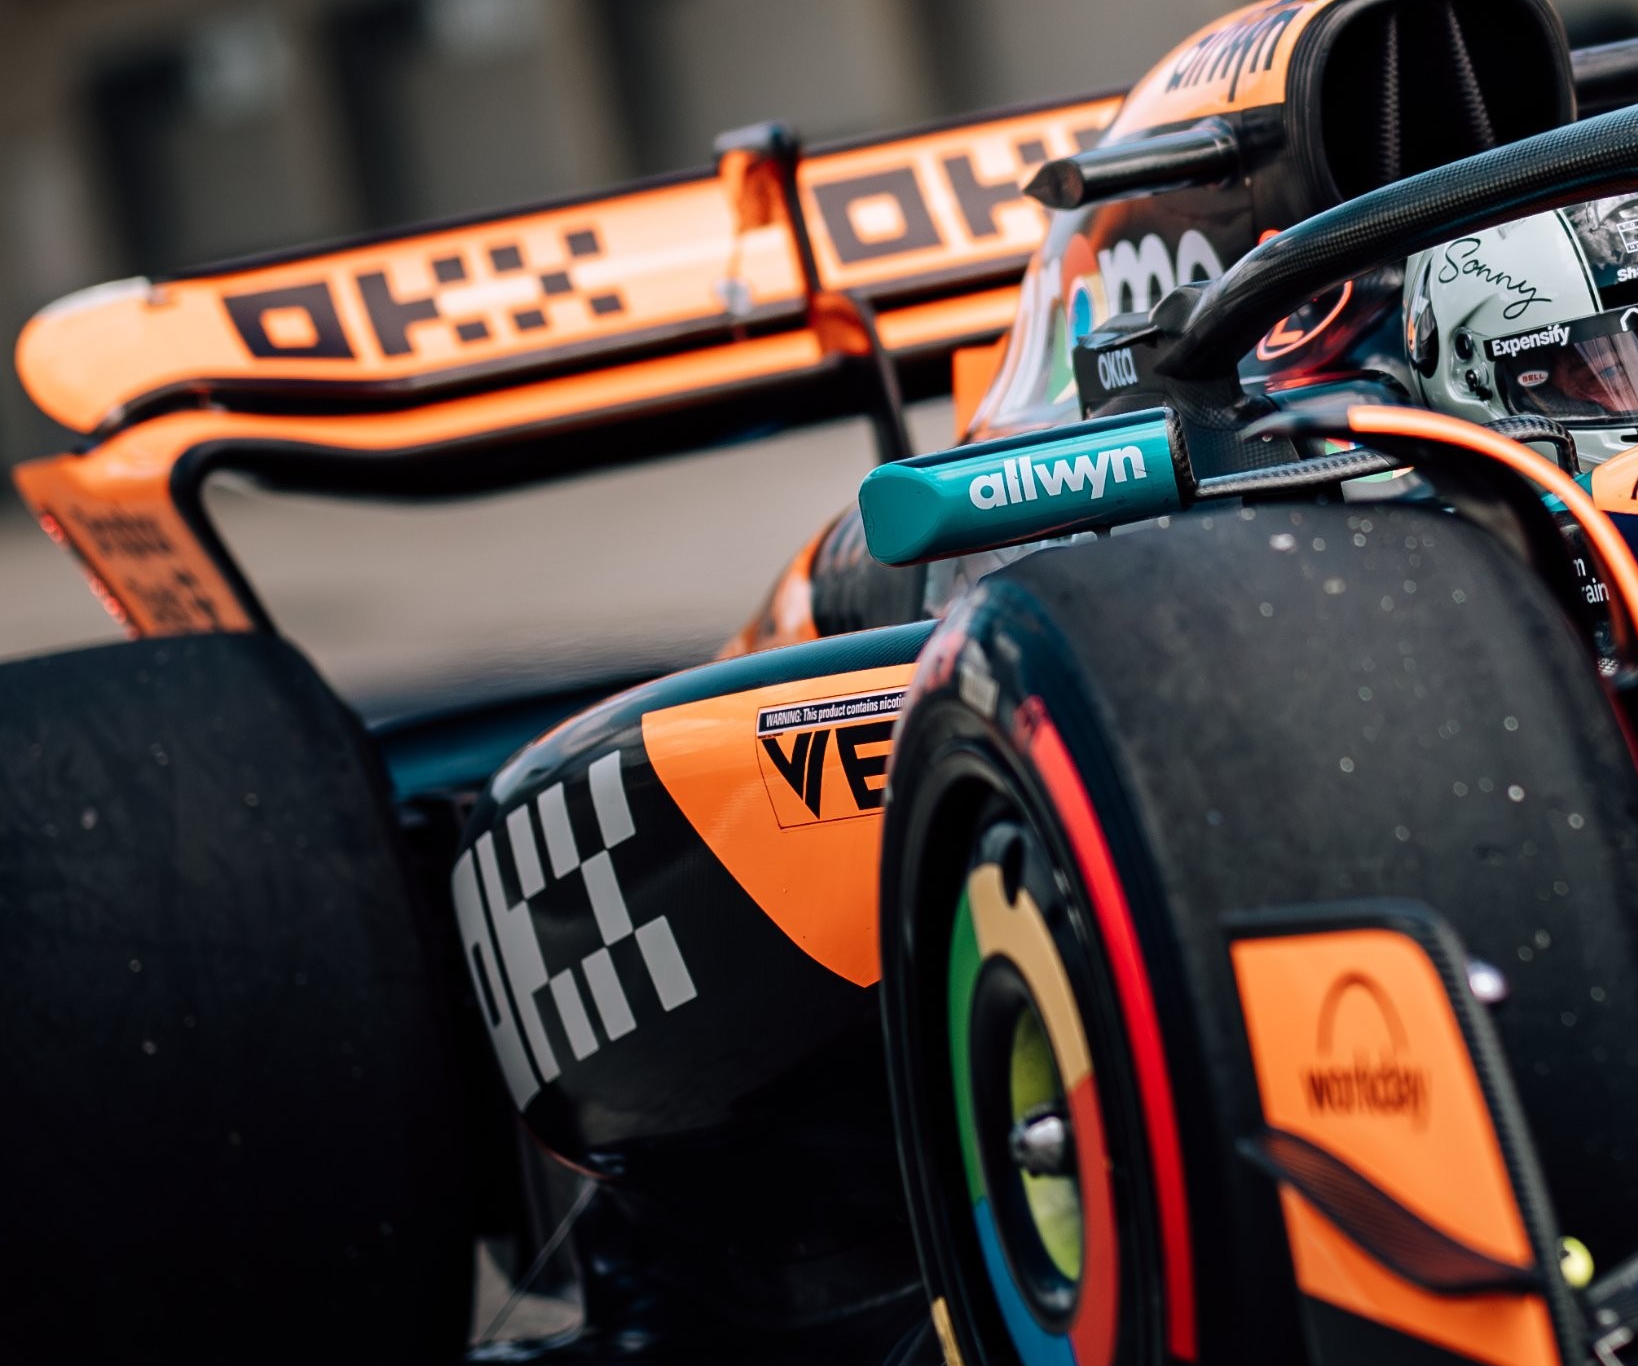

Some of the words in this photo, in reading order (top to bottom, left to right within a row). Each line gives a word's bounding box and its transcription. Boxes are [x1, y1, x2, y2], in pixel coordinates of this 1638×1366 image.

[1439, 237, 1552, 319] Sonny
[1491, 324, 1570, 357] Expensify
[1097, 346, 1138, 390] okta
[1521, 372, 1546, 383] BELL
[969, 442, 1146, 510] allwyn
[766, 709, 802, 728] WARNING:
[803, 707, 818, 722] This
[818, 704, 846, 722] product
[847, 699, 879, 715] contains
